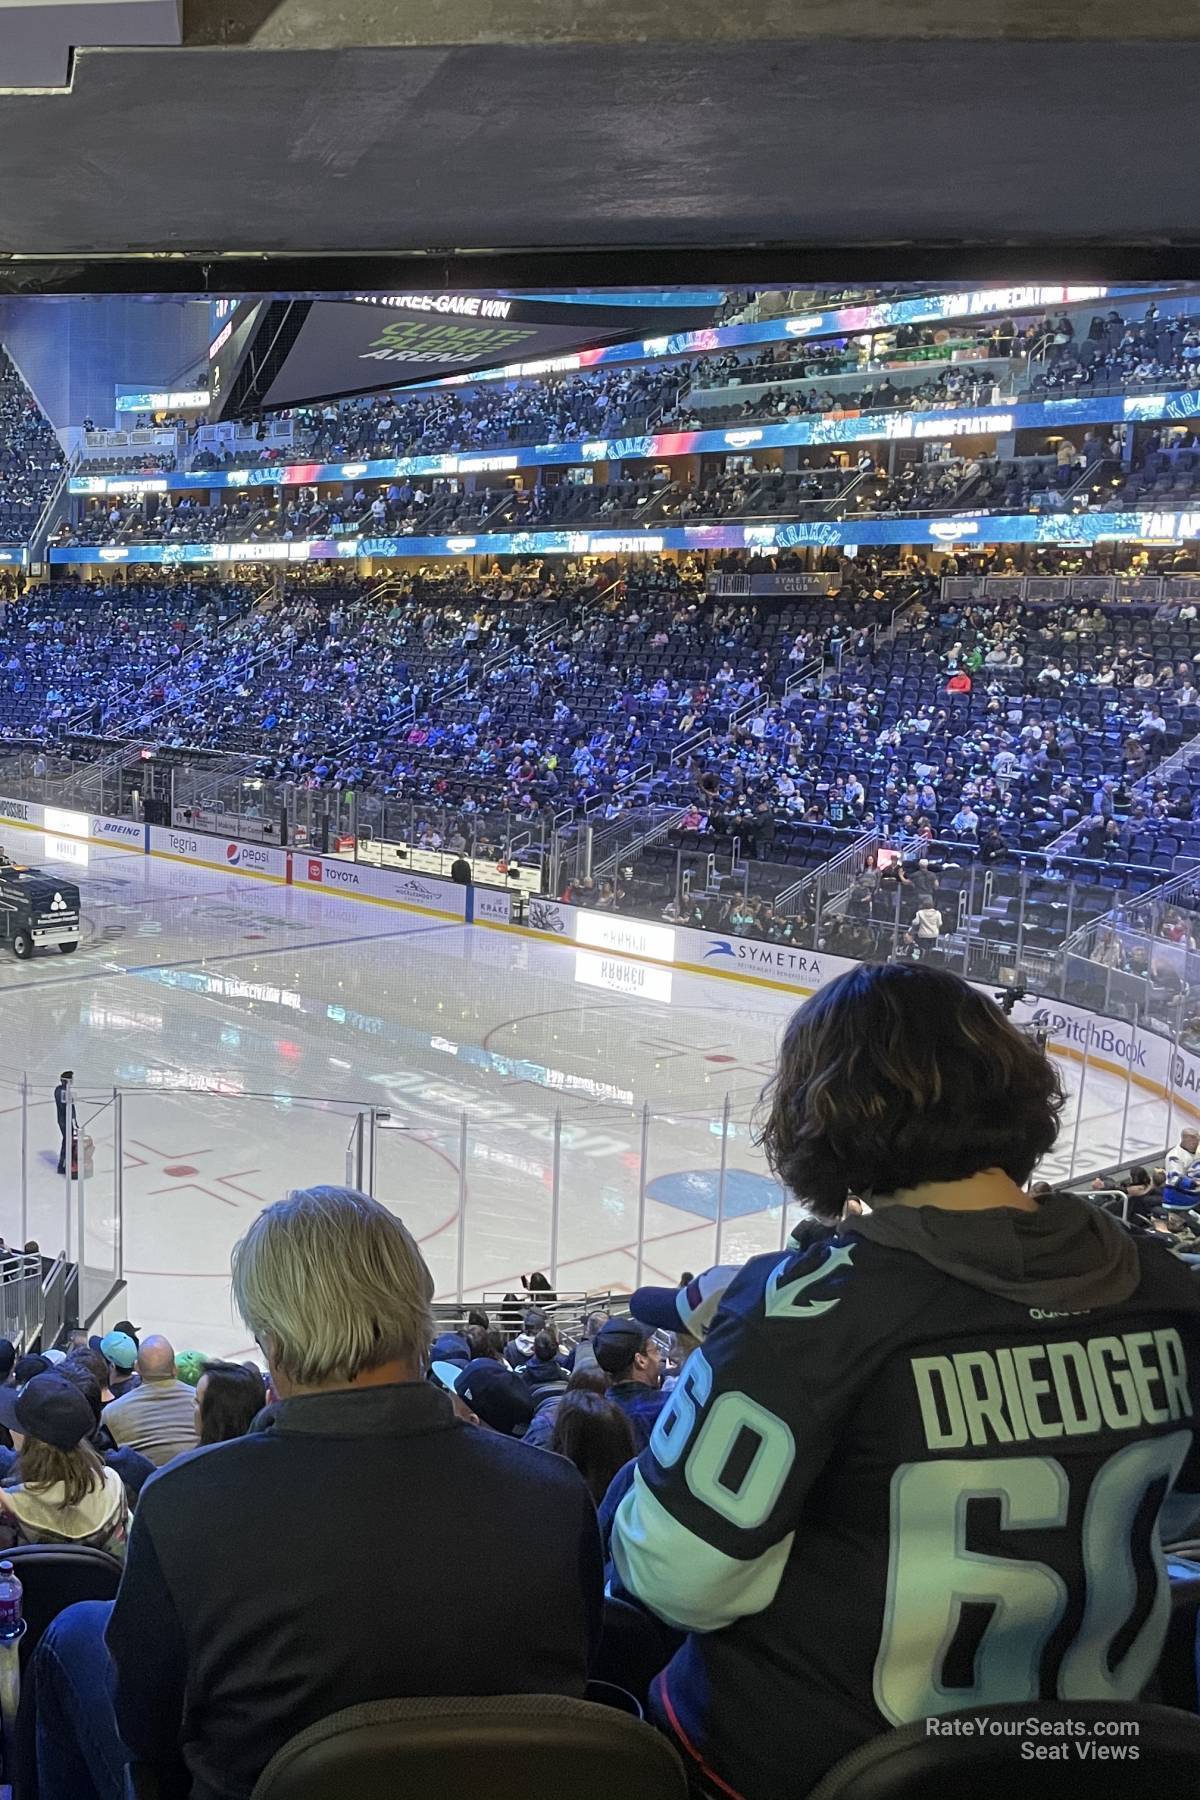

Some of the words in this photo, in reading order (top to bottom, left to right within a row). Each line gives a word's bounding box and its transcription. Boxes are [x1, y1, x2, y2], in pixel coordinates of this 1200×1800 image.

[480, 300, 511, 319] WIN
[381, 321, 539, 343] CLIMATE
[368, 335, 511, 354] PLEDGE
[359, 348, 484, 363] ARENA
[776, 522, 842, 546] KRAKEN
[774, 576, 821, 584] SYMETRA
[784, 584, 808, 592] CLUB
[103, 822, 141, 837] BOEING
[168, 834, 197, 854] Tegria
[242, 848, 270, 863] pepsi
[325, 868, 360, 884] TOYOTA
[738, 945, 821, 974] SYMETRA
[1051, 1013, 1147, 1068] PitchBook
[910, 1328, 1193, 1450] DRIEDGER
[649, 1347, 796, 1529] 60
[872, 1429, 1193, 1727] 60
